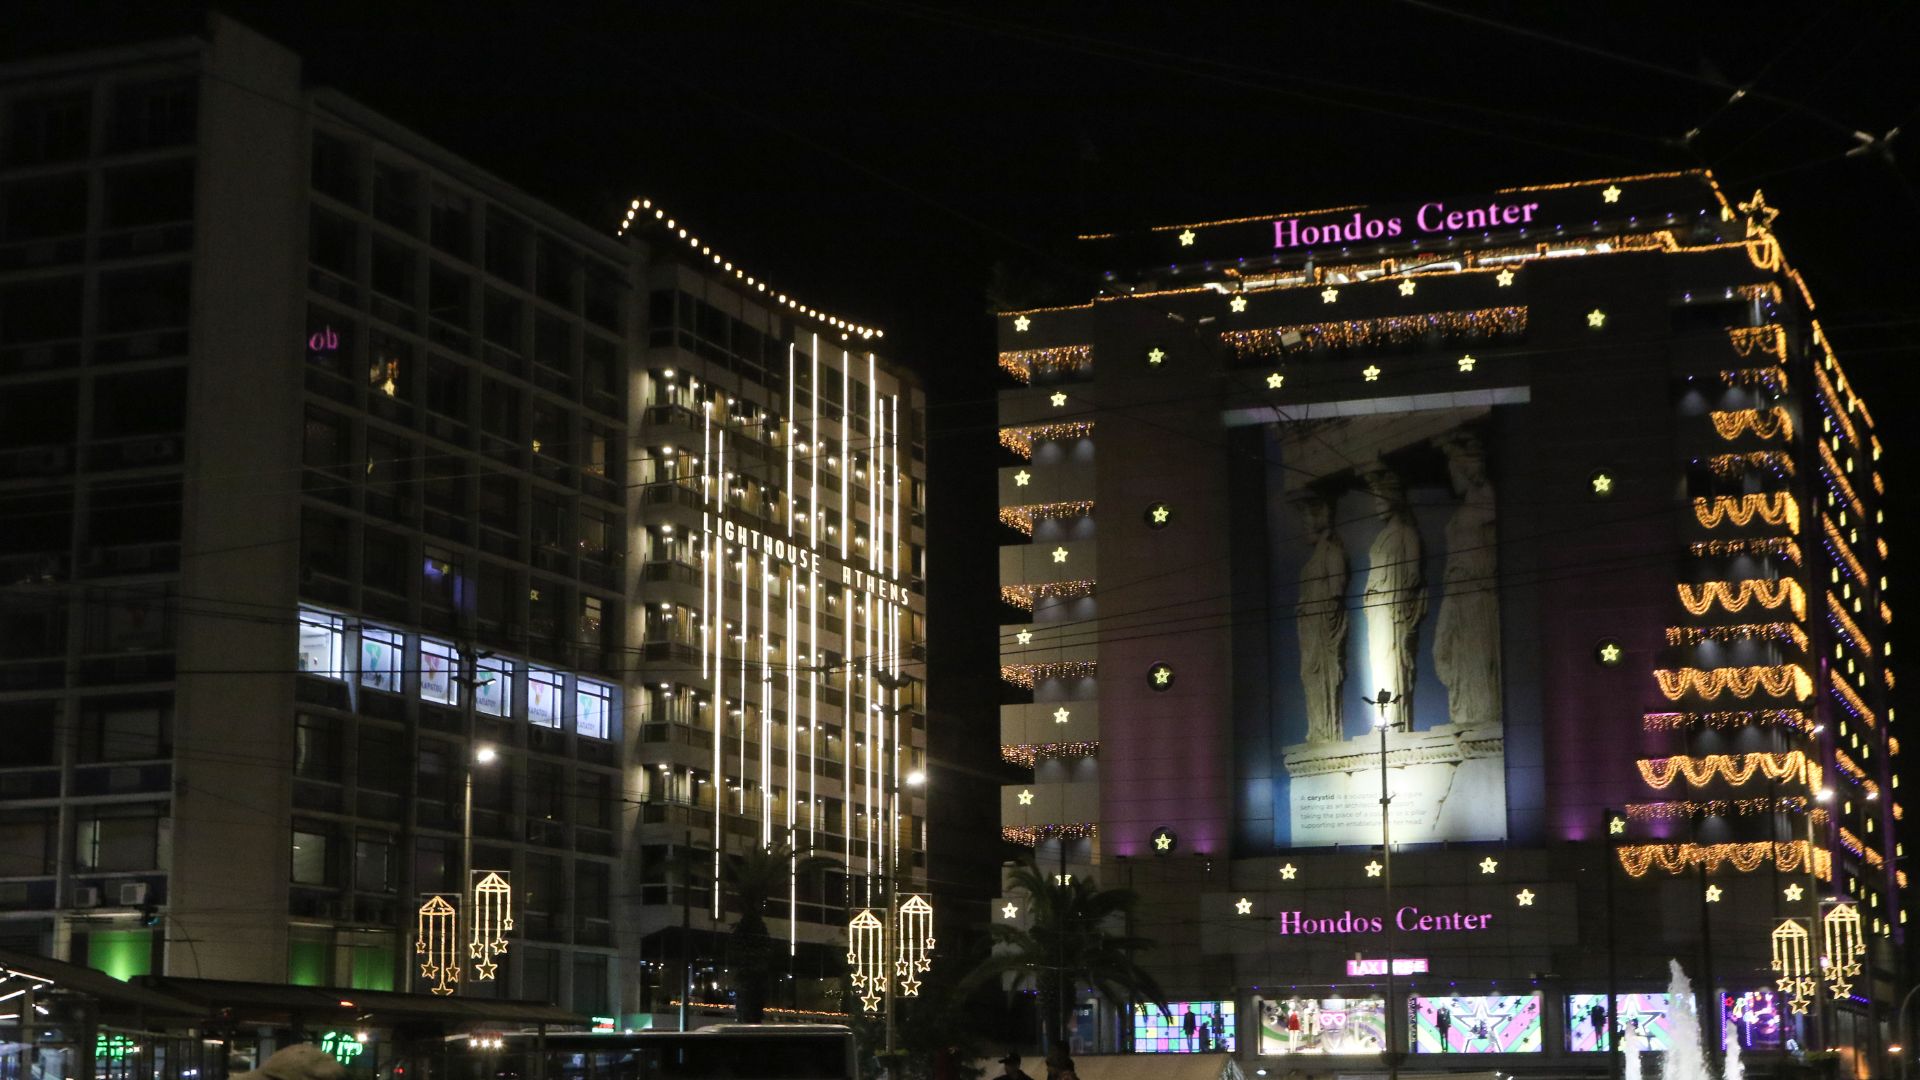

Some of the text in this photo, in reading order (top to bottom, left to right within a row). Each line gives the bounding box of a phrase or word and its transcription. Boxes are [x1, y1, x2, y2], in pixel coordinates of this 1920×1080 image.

[1273, 202, 1539, 248] Hondos Center
[703, 512, 909, 606] LIGHTHOUSE ATHENS
[1280, 906, 1492, 934] Hondos Center
